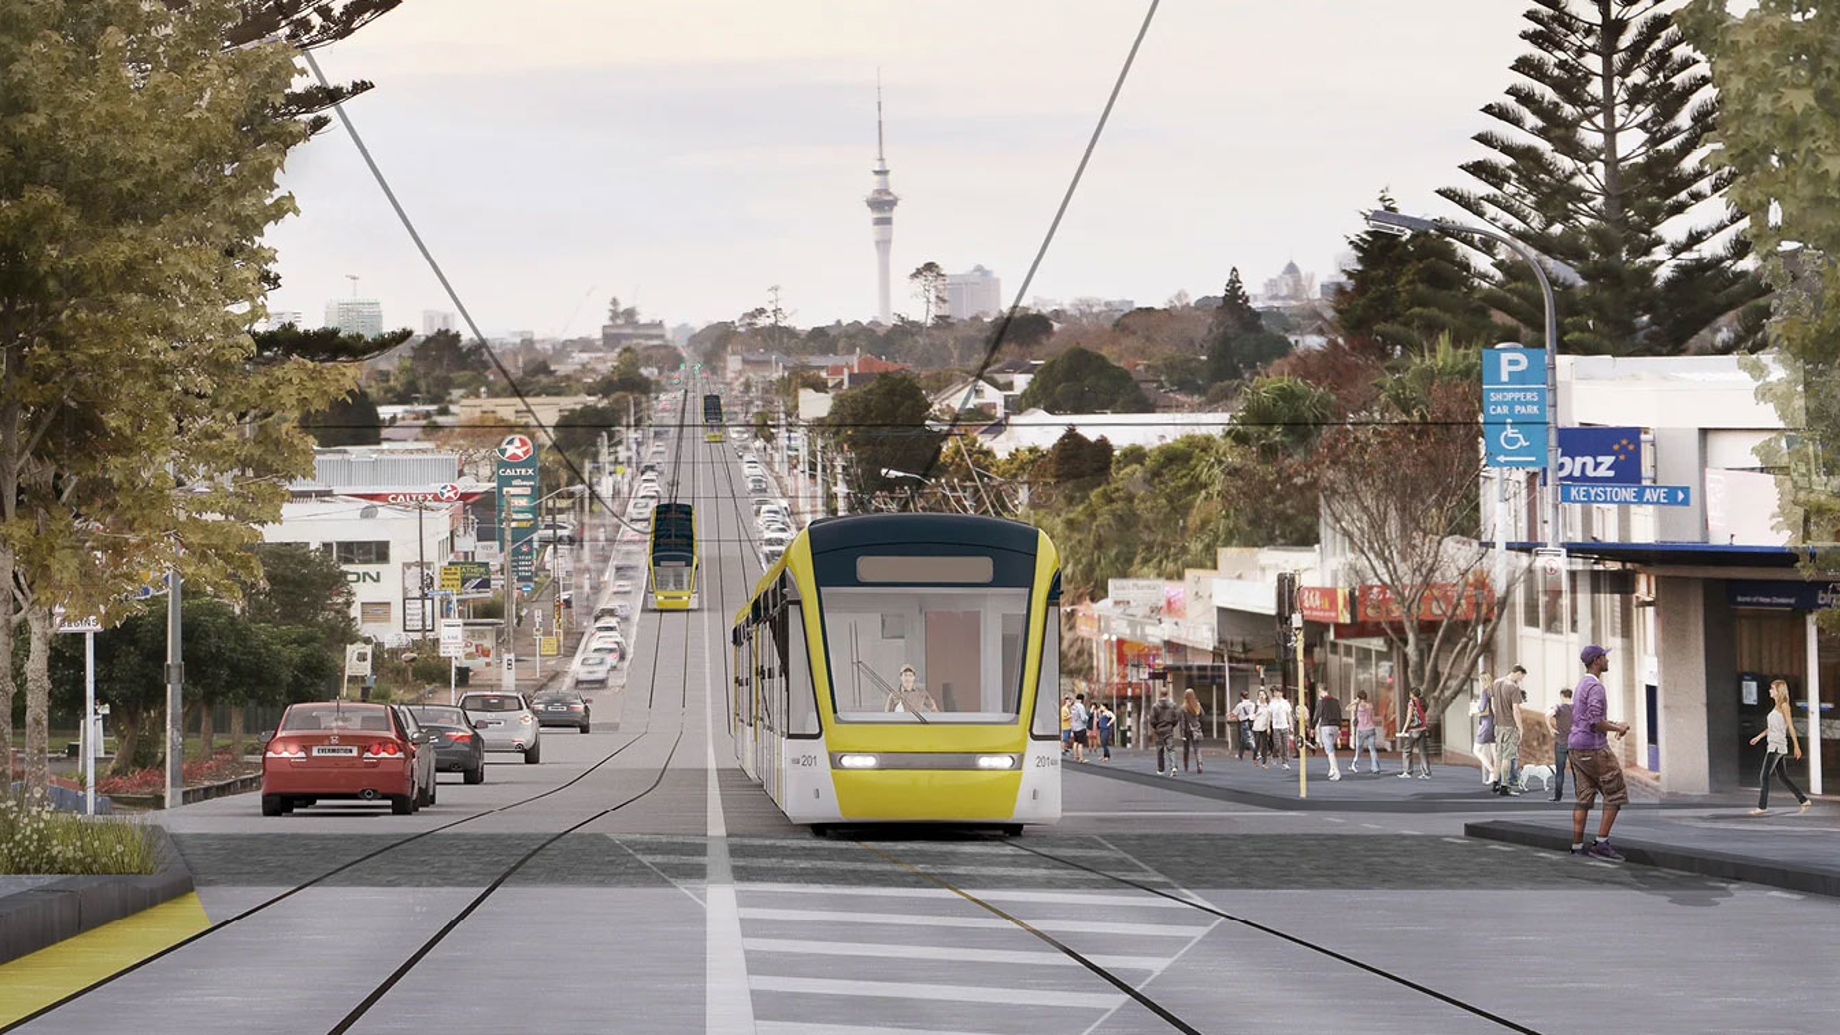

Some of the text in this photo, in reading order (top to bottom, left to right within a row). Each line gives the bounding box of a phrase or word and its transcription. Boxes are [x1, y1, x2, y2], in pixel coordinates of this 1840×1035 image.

[1500, 352, 1529, 382] P
[1489, 392, 1539, 402] SHOPPERS
[1489, 404, 1540, 415] CAR PARK
[1557, 448, 1616, 477] bnz
[498, 468, 535, 476] CALTEX
[388, 493, 434, 503] CALTEX
[1570, 486, 1669, 503] KEYSTONE AVE
[801, 754, 817, 767] 201
[1036, 755, 1050, 768] 201
